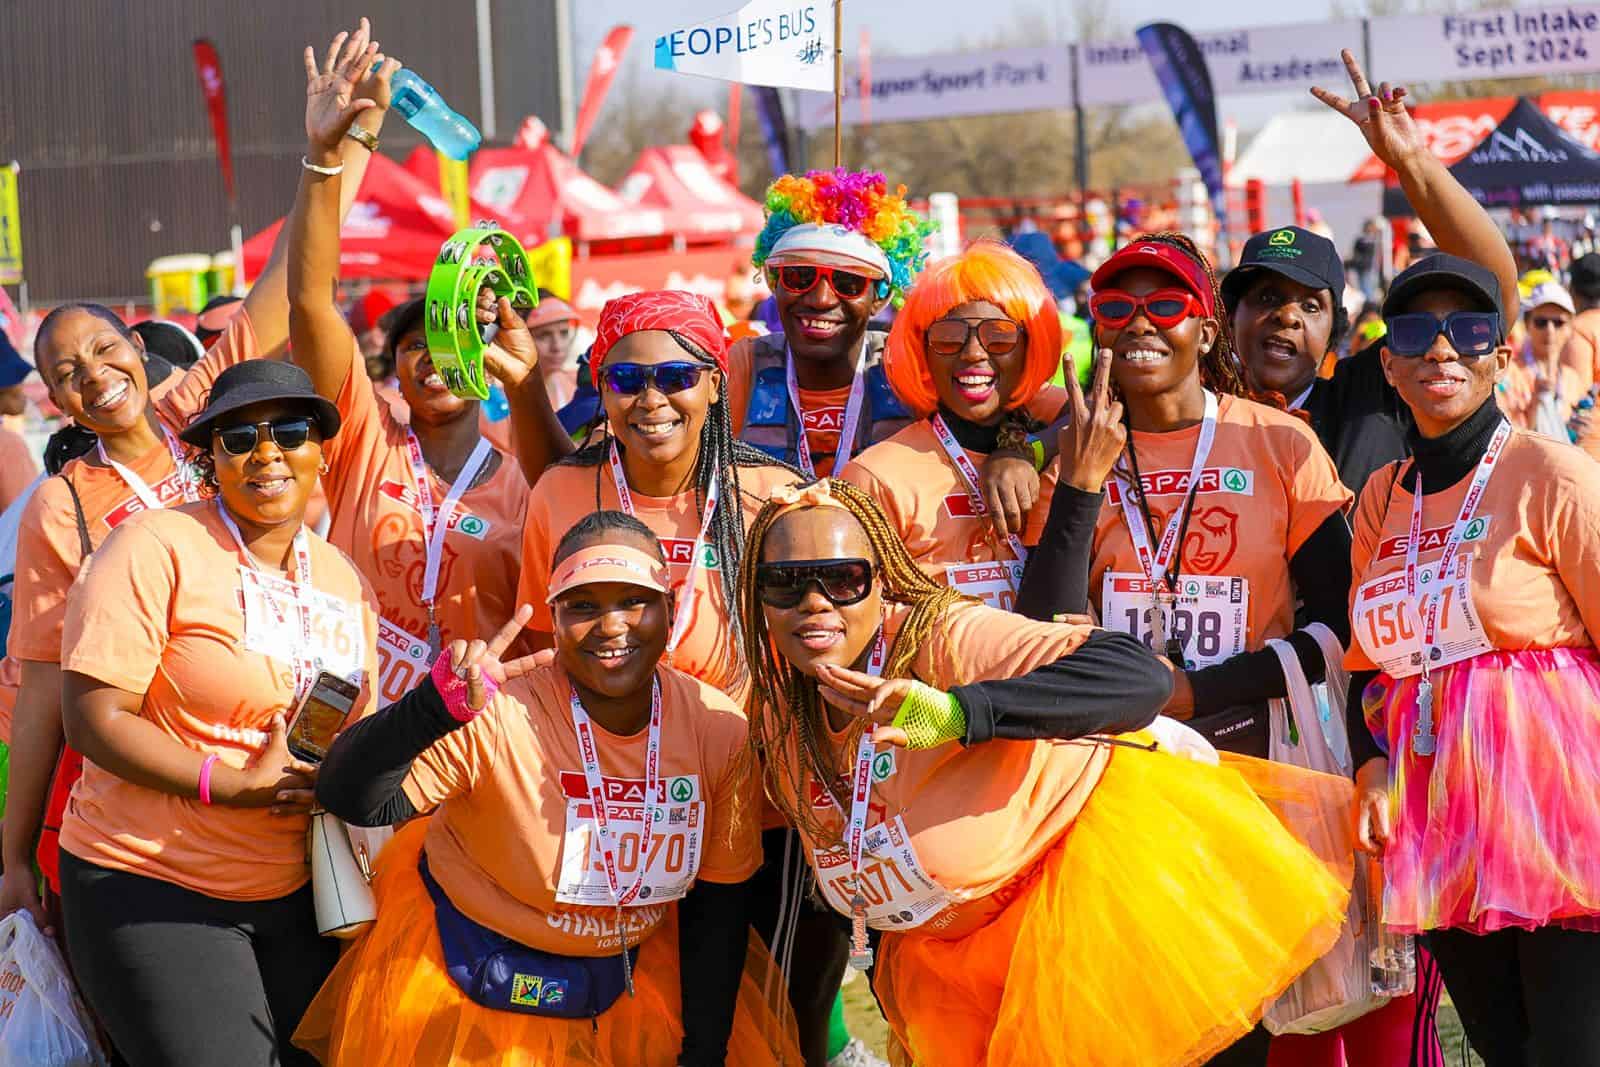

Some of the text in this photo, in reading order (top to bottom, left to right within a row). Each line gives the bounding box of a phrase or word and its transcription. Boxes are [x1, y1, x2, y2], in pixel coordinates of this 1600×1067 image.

[779, 7, 815, 41] BUS
[1443, 10, 1598, 39] First Intake
[1456, 38, 1588, 69] Sept 2024
[1239, 60, 1344, 81] Academ
[124, 478, 184, 513] SAR
[1375, 577, 1406, 594] SPA
[379, 626, 409, 652] PAR
[606, 782, 665, 802] PAR
[607, 807, 644, 819] PAR
